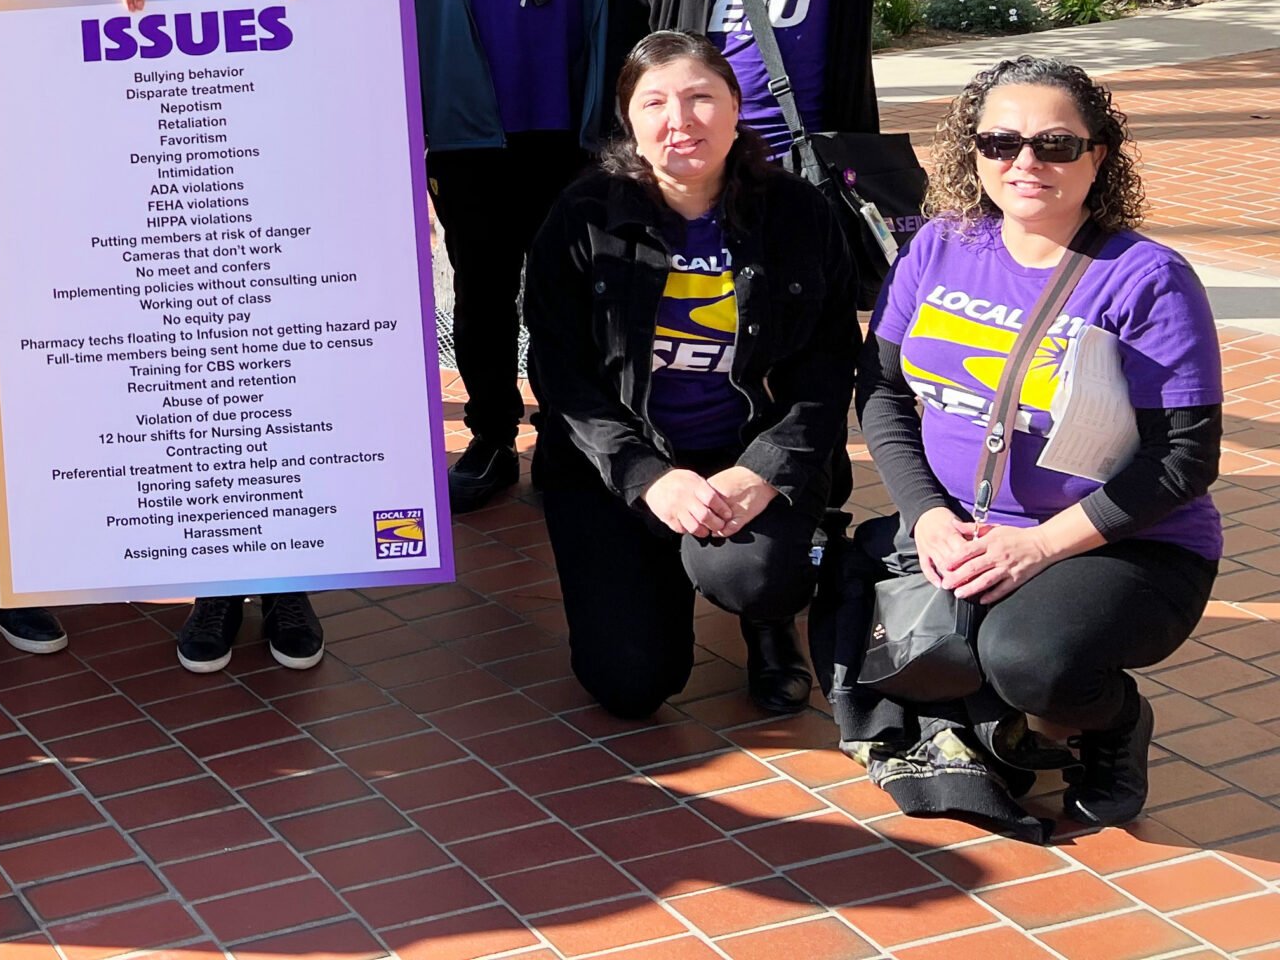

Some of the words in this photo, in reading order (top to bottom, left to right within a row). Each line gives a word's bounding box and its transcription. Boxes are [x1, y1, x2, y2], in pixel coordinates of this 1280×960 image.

[81, 6, 293, 63] ISSUES
[133, 70, 185, 85] Bullying
[188, 66, 245, 80] behavior
[126, 86, 188, 101] Disparate
[191, 81, 255, 96] treatment
[160, 100, 223, 116] Nepotism
[157, 116, 227, 131] Retaliation
[159, 132, 228, 147] Favoritism
[130, 151, 183, 166] Denying
[185, 146, 260, 164] promotions
[157, 164, 234, 179] Intimidation
[150, 183, 180, 196] ADA
[181, 180, 245, 194] violations
[147, 199, 185, 212] FEHA
[186, 196, 250, 210] violations
[146, 215, 188, 229] HIPPA
[190, 212, 253, 226] violations
[91, 235, 138, 249] Putting
[140, 231, 202, 245] members
[204, 229, 219, 242] at
[221, 228, 246, 241] risk
[248, 226, 262, 239] of
[265, 226, 312, 239] danger
[122, 250, 181, 263] Cameras
[183, 247, 210, 259] that
[212, 244, 247, 258] don't
[248, 242, 283, 255] work
[135, 266, 155, 278] No
[157, 264, 191, 277] meet
[193, 262, 218, 275] and
[221, 260, 271, 273] confers
[671, 254, 722, 272] CAL
[52, 283, 141, 301] Implementing
[144, 280, 195, 297] policies
[197, 277, 247, 291] without
[249, 273, 318, 288] consulting
[320, 271, 357, 284] union
[138, 297, 193, 311] Working
[196, 295, 219, 308] out
[221, 293, 235, 306] of
[237, 293, 272, 305] class
[925, 284, 1025, 331] LOCAL
[1047, 313, 1084, 337] 21
[162, 313, 182, 326] No
[184, 311, 225, 326] equity
[227, 311, 251, 325] pay
[20, 338, 85, 351] Pharmacy
[88, 334, 125, 347] techs
[126, 330, 177, 345] floating
[179, 330, 194, 341] to
[196, 326, 249, 341] Infusion
[251, 325, 274, 337] not
[276, 322, 323, 338] getting
[325, 318, 371, 333] hazard
[373, 319, 398, 333] pay
[46, 351, 103, 365] Full-time
[106, 348, 168, 362] members
[170, 345, 207, 359] being
[210, 343, 239, 356] sent
[241, 342, 279, 354] home
[281, 339, 307, 352] due
[309, 339, 324, 350] to
[326, 337, 374, 349] census
[128, 363, 181, 377] Training
[183, 362, 204, 374] for
[206, 359, 236, 373] CBS
[238, 357, 292, 371] workers
[127, 378, 208, 394] Recruitment
[210, 375, 235, 389] and
[238, 373, 297, 387] retention
[162, 395, 203, 408] Abuse
[206, 393, 220, 406] of
[222, 393, 265, 407] power
[135, 412, 193, 426] Violation
[195, 410, 209, 423] of
[212, 409, 237, 422] due
[240, 408, 293, 423] process
[98, 432, 115, 445] 12
[116, 432, 148, 444] hour
[150, 428, 186, 442] shifts
[188, 427, 209, 440] for
[211, 424, 262, 439] Nursing
[264, 420, 334, 435] Assistants
[165, 442, 243, 458] Contracting
[245, 440, 269, 453] out
[51, 465, 127, 481] Preferential
[129, 461, 194, 476] treatment
[195, 461, 210, 473] to
[212, 459, 247, 471] extra
[249, 456, 278, 471] help
[281, 454, 306, 468] and
[308, 451, 385, 466] contractors
[137, 478, 192, 495] Ignoring
[194, 476, 235, 490] safety
[237, 474, 302, 487] measures
[137, 495, 183, 509] Hostile
[185, 492, 220, 506] work
[222, 488, 304, 504] environment
[106, 512, 174, 527] Promoting
[177, 506, 269, 525] inexperienced
[272, 505, 338, 518] managers
[375, 511, 405, 520] LOCAL
[406, 510, 422, 518] 721
[183, 524, 263, 540] Harassment
[123, 545, 188, 561] Assigning
[191, 544, 230, 556] cases
[232, 540, 267, 553] while
[270, 541, 287, 551] on
[290, 538, 325, 550] leave
[378, 541, 424, 557] SEIU
